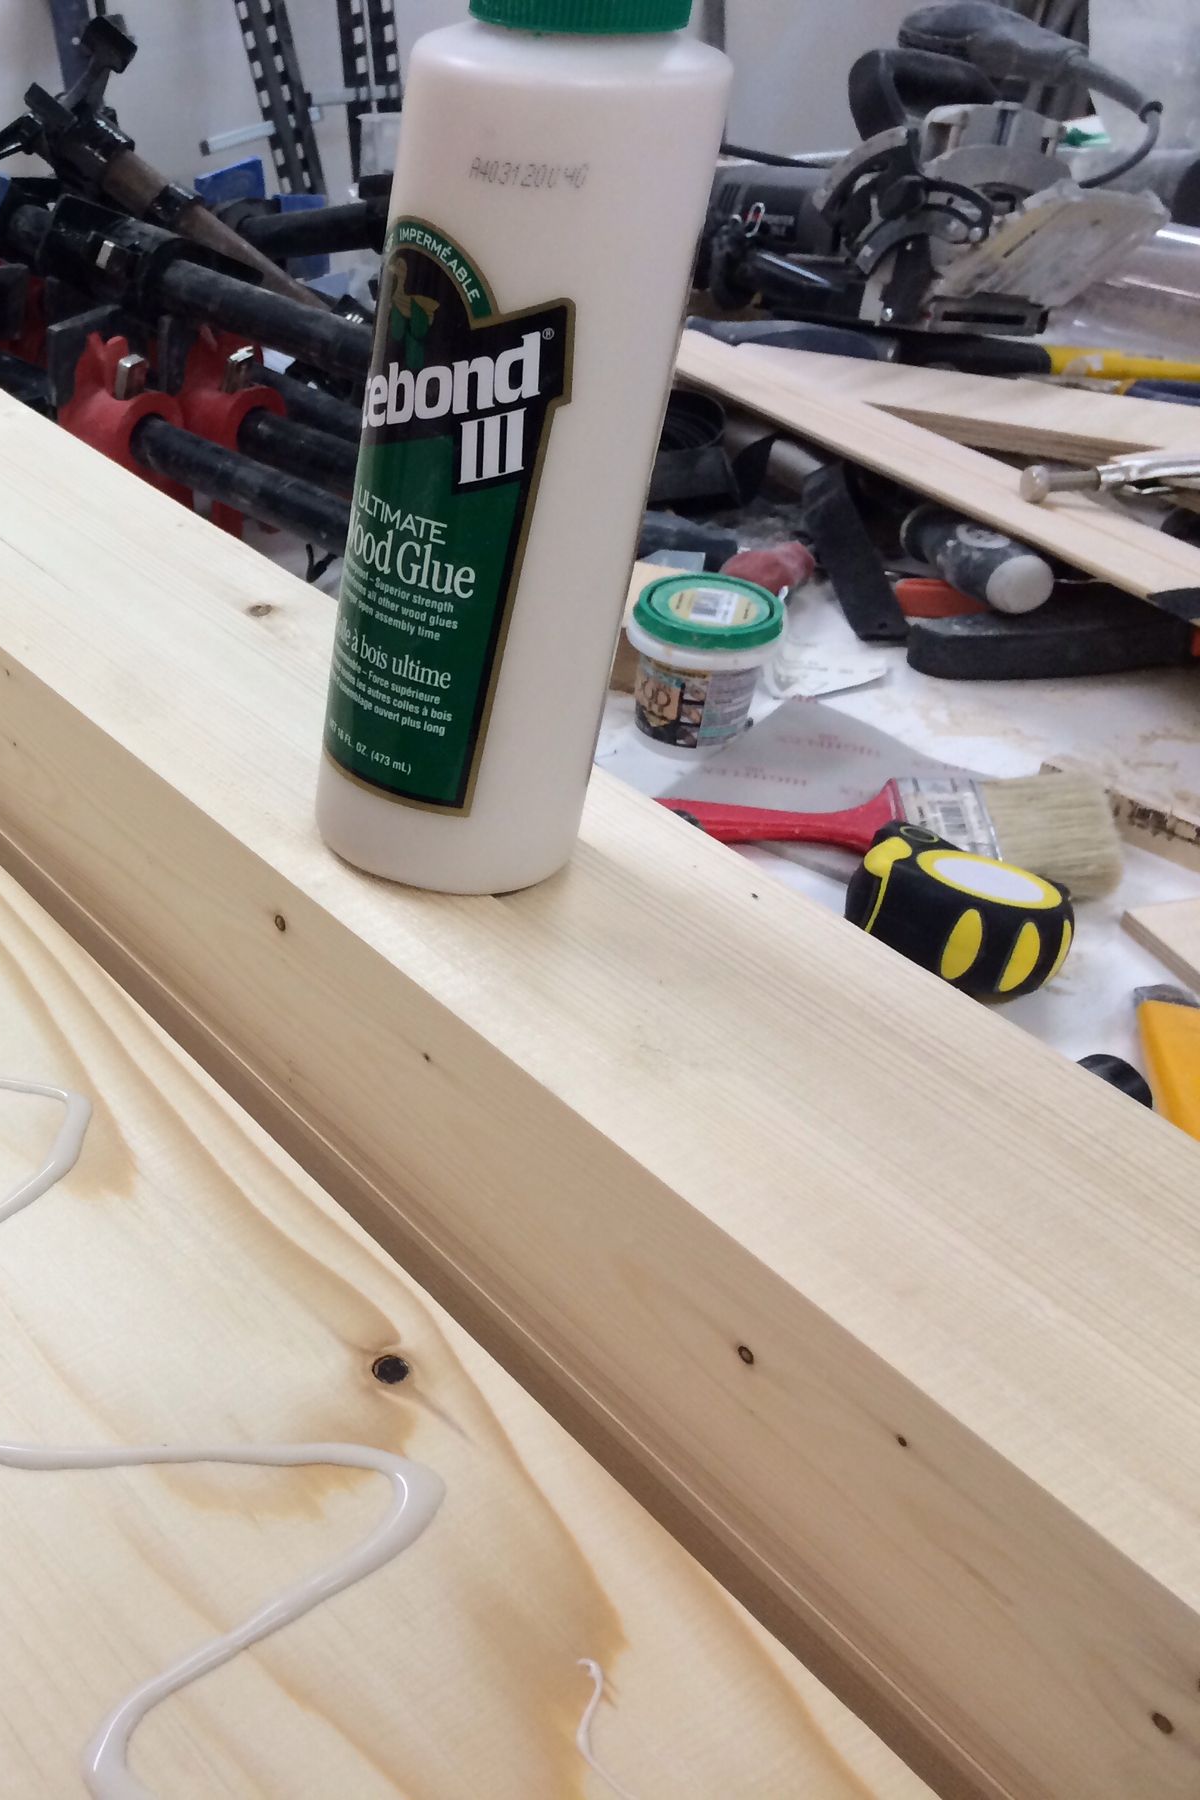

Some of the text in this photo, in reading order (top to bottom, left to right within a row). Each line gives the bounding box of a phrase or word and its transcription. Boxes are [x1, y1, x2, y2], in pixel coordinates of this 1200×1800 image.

[400, 228, 480, 303] IMPERMÉABLE
[362, 331, 541, 429] ebond
[458, 407, 527, 485] III
[358, 484, 448, 545] ULTIMATE
[396, 540, 476, 598] Glue
[374, 576, 411, 601] Superior
[411, 594, 454, 613] strength
[378, 596, 401, 612] other
[401, 606, 427, 622] wood
[429, 615, 459, 630] glues
[374, 610, 416, 636] assembly
[417, 625, 441, 641] time
[351, 628, 358, 654] à
[360, 634, 388, 670] bois
[392, 654, 451, 690] ultime
[367, 686, 391, 704] autres
[392, 698, 420, 714] colles
[421, 705, 428, 716] à
[430, 708, 453, 722] bois
[368, 670, 390, 688] Force
[390, 682, 441, 705] supérieure
[373, 705, 400, 723] ouvert
[401, 715, 421, 730] plus
[423, 721, 446, 737] long
[370, 750, 391, 766] (473
[392, 760, 412, 776] mL)
